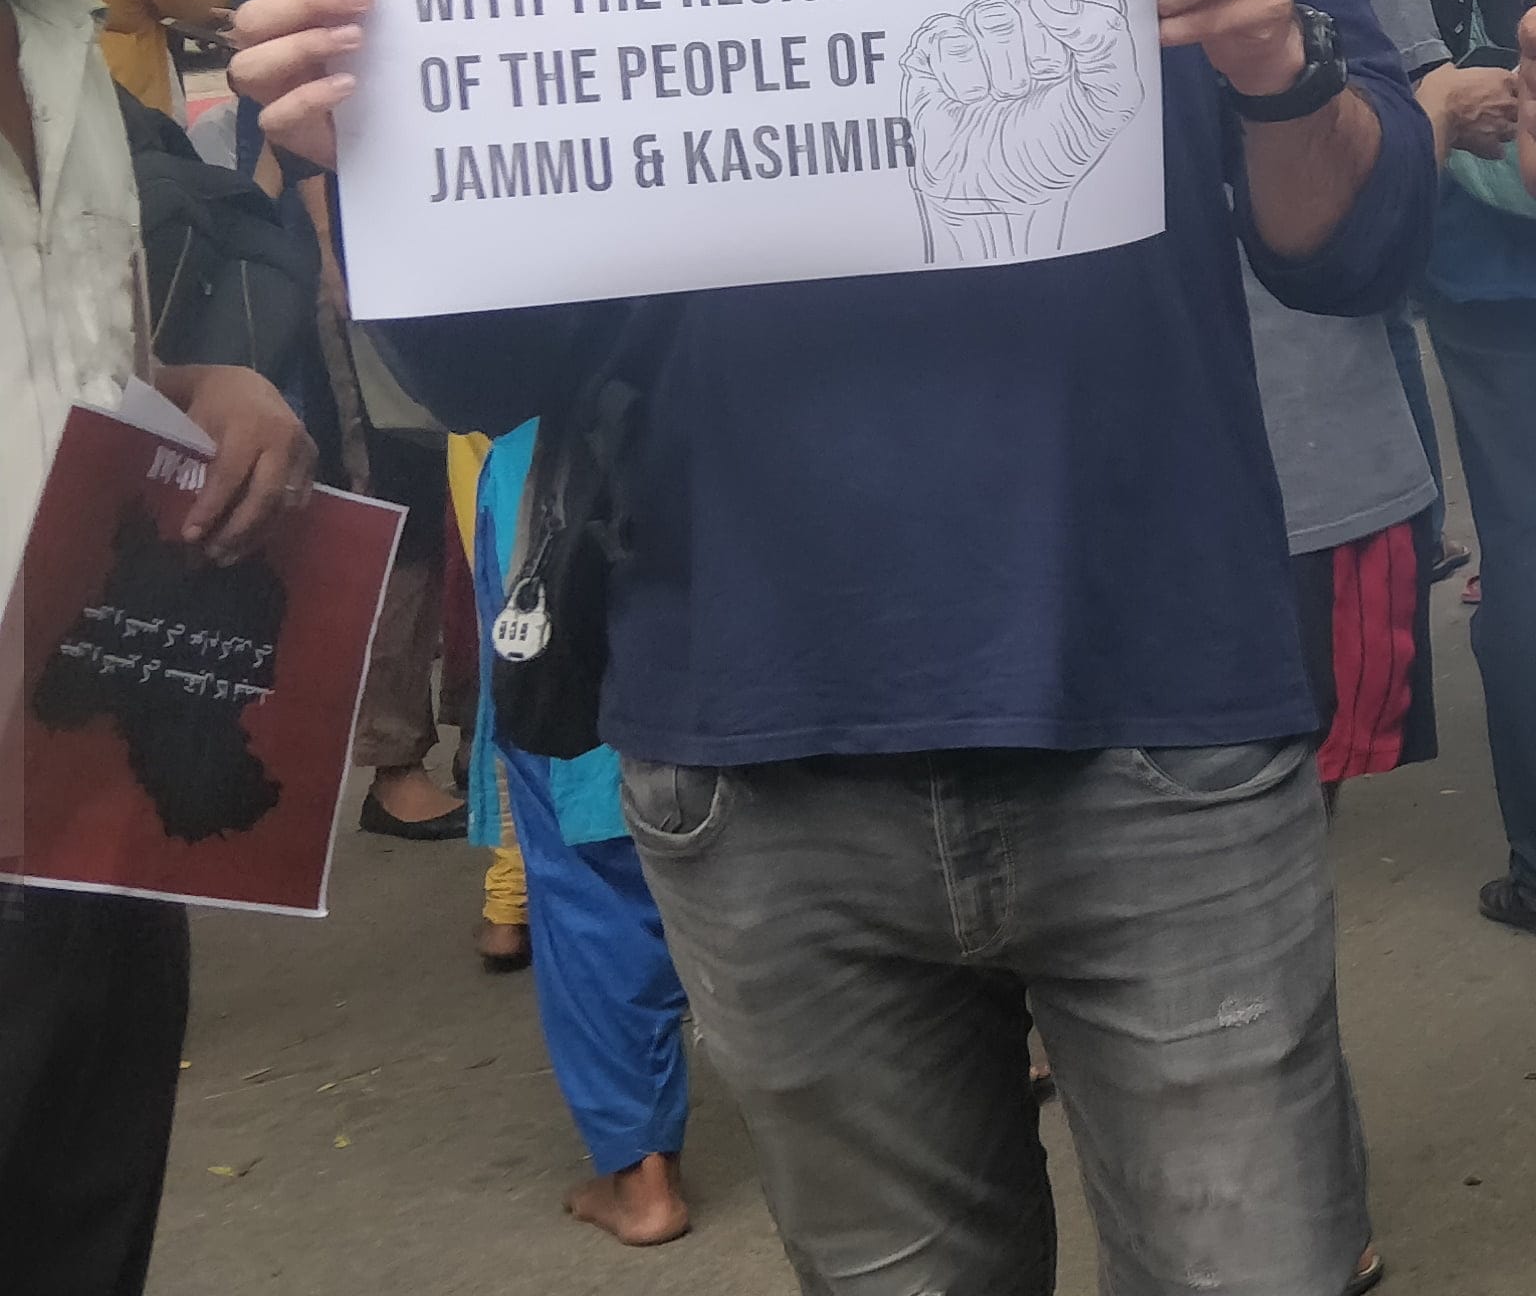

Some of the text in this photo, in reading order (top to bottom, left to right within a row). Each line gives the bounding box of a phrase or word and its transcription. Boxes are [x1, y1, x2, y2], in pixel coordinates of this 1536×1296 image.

[420, 30, 886, 114] OF THE PEOPLE OF
[430, 115, 916, 203] JAMMU & KASHMIR
